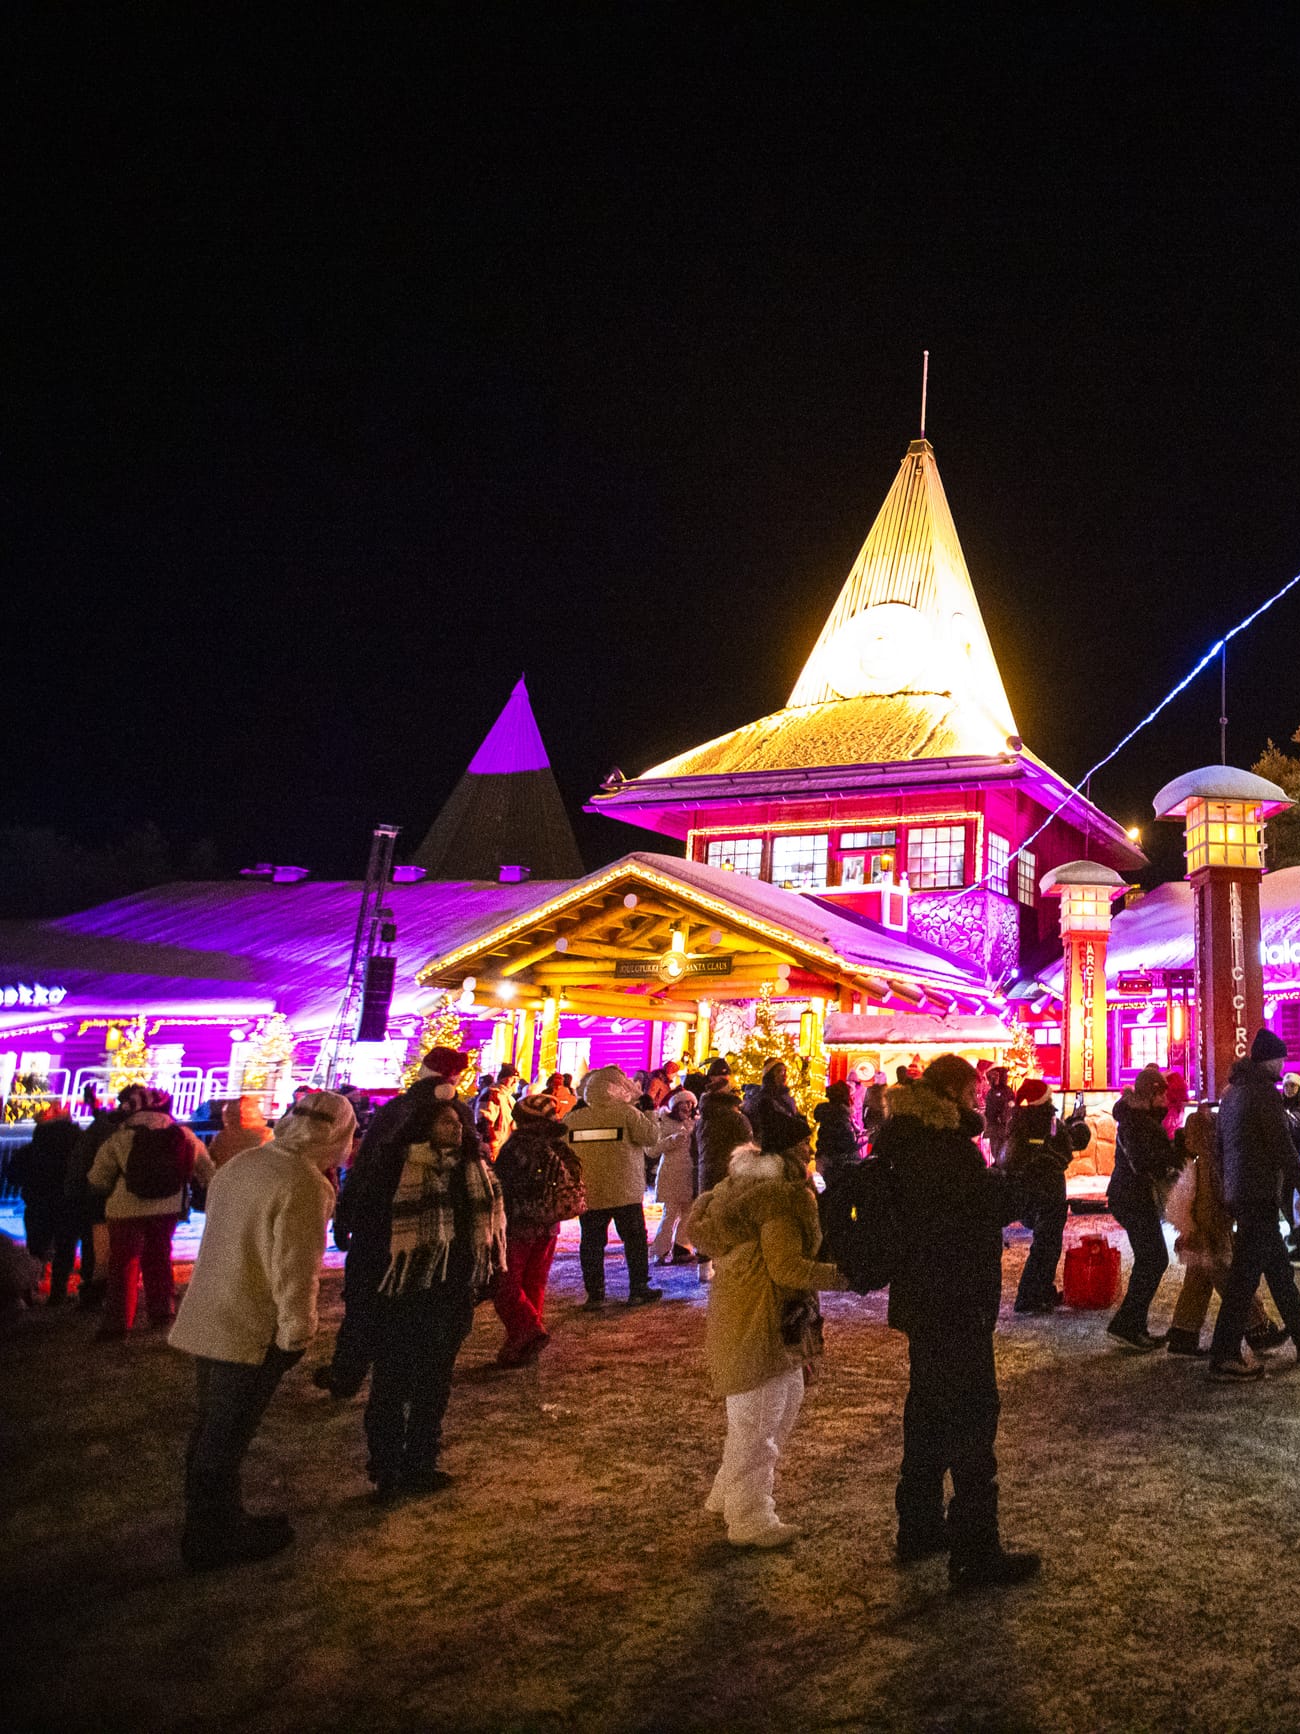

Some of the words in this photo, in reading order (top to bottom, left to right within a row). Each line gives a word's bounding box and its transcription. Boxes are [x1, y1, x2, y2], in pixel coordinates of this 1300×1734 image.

[686, 963, 706, 972] SANTA
[706, 962, 728, 970] CLAUS
[1085, 943, 1095, 1009] ARCTIC
[1084, 1016, 1094, 1081] CIRCLE
[1232, 995, 1247, 1058] CIRC
